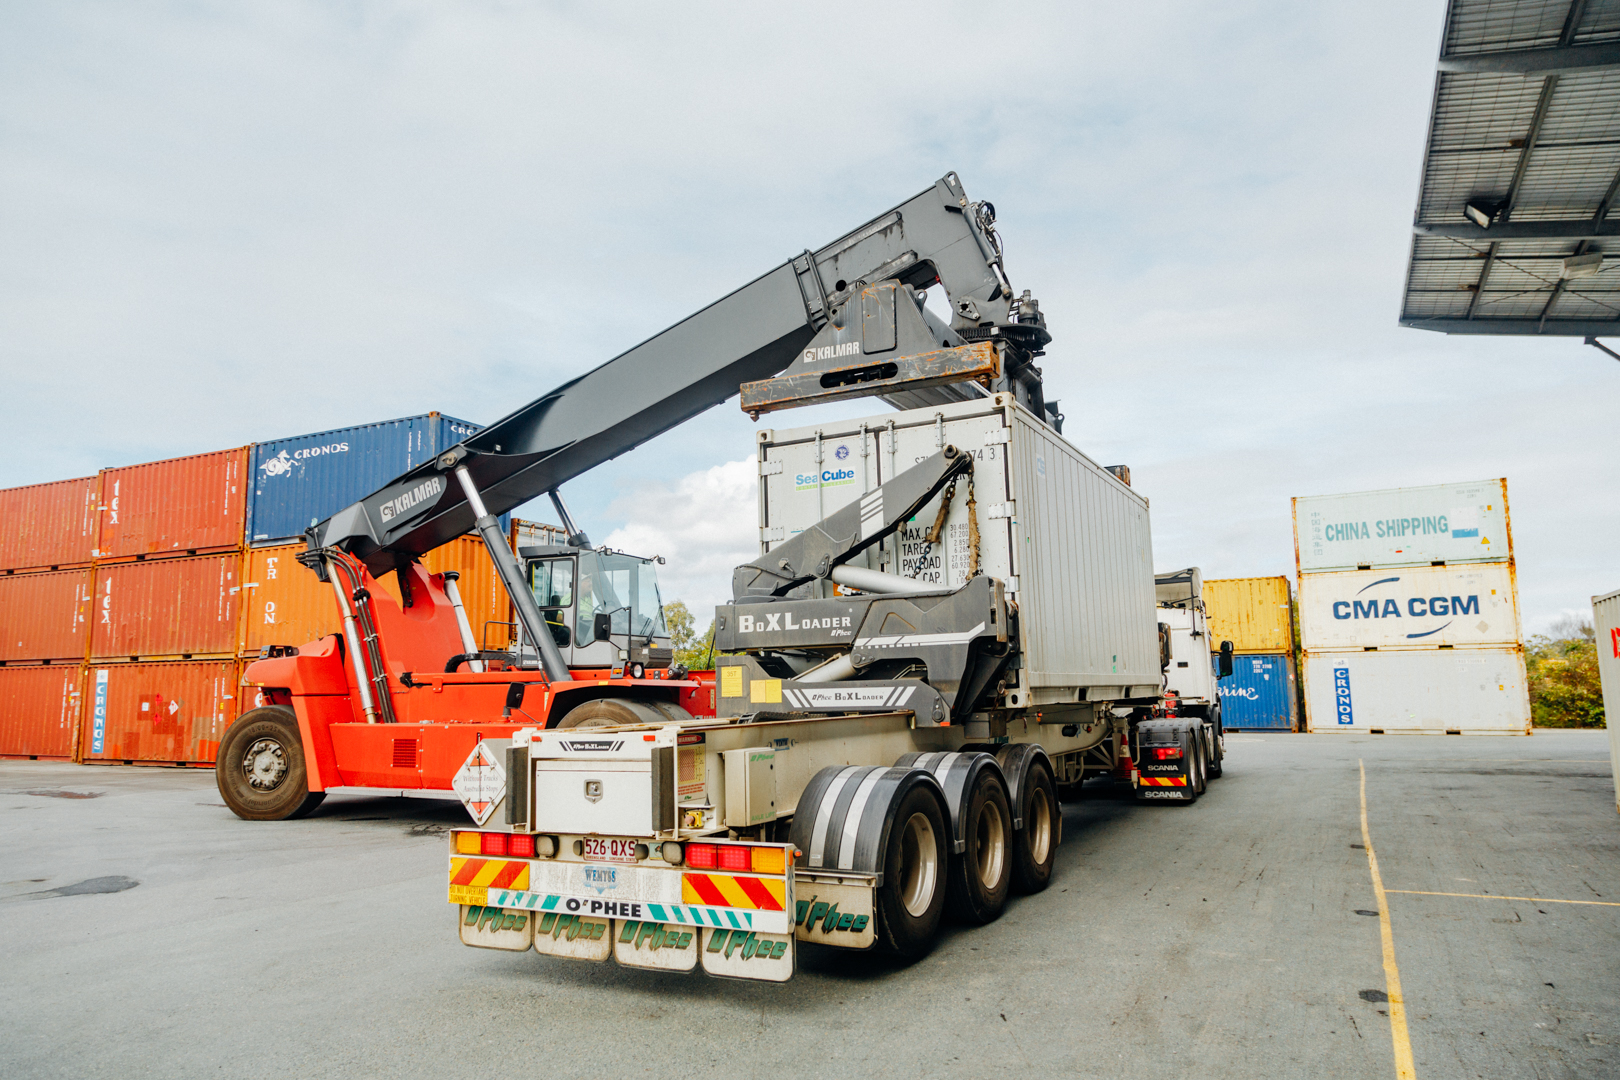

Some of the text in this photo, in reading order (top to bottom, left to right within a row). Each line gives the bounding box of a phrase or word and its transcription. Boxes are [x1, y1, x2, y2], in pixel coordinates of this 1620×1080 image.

[817, 341, 860, 360] KALMAR
[293, 442, 349, 460] CRONOS
[989, 447, 996, 461] 3
[109, 479, 120, 524] tex
[394, 477, 441, 515] KALMAR
[1325, 515, 1449, 542] CHINA SHIPPING
[902, 544, 924, 557] TARE
[101, 576, 112, 624] tex
[1332, 595, 1480, 620] CMA CGM
[1335, 670, 1351, 723] CRONOS
[93, 685, 105, 750] CRONOS
[566, 898, 641, 918] O'PHEE
